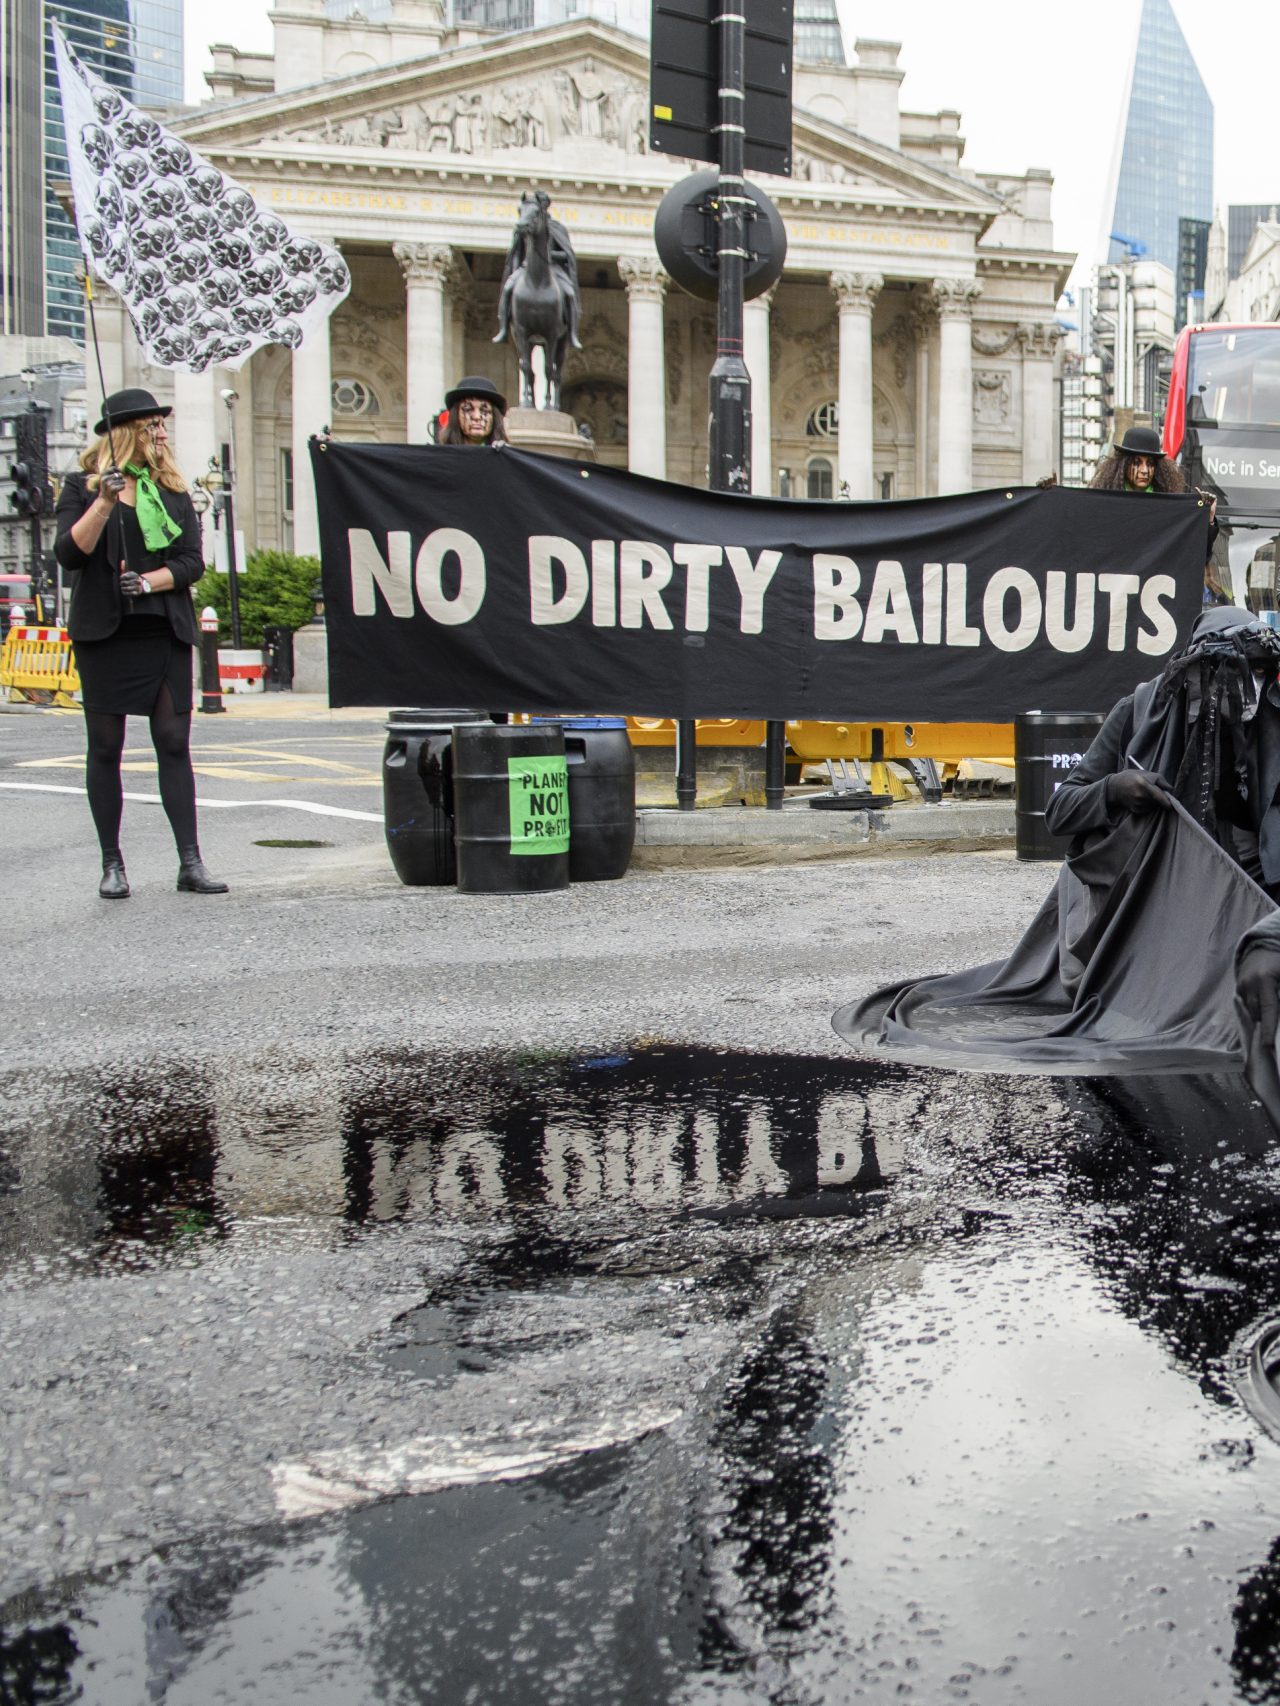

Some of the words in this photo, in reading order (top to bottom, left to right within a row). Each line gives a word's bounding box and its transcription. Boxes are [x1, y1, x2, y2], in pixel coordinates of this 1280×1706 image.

[1206, 458, 1236, 475] Not
[1240, 460, 1254, 476] in
[348, 527, 487, 626] NO
[528, 535, 783, 634] DIRTY
[813, 553, 1178, 656] BAILOUTS
[530, 792, 564, 816] NOT
